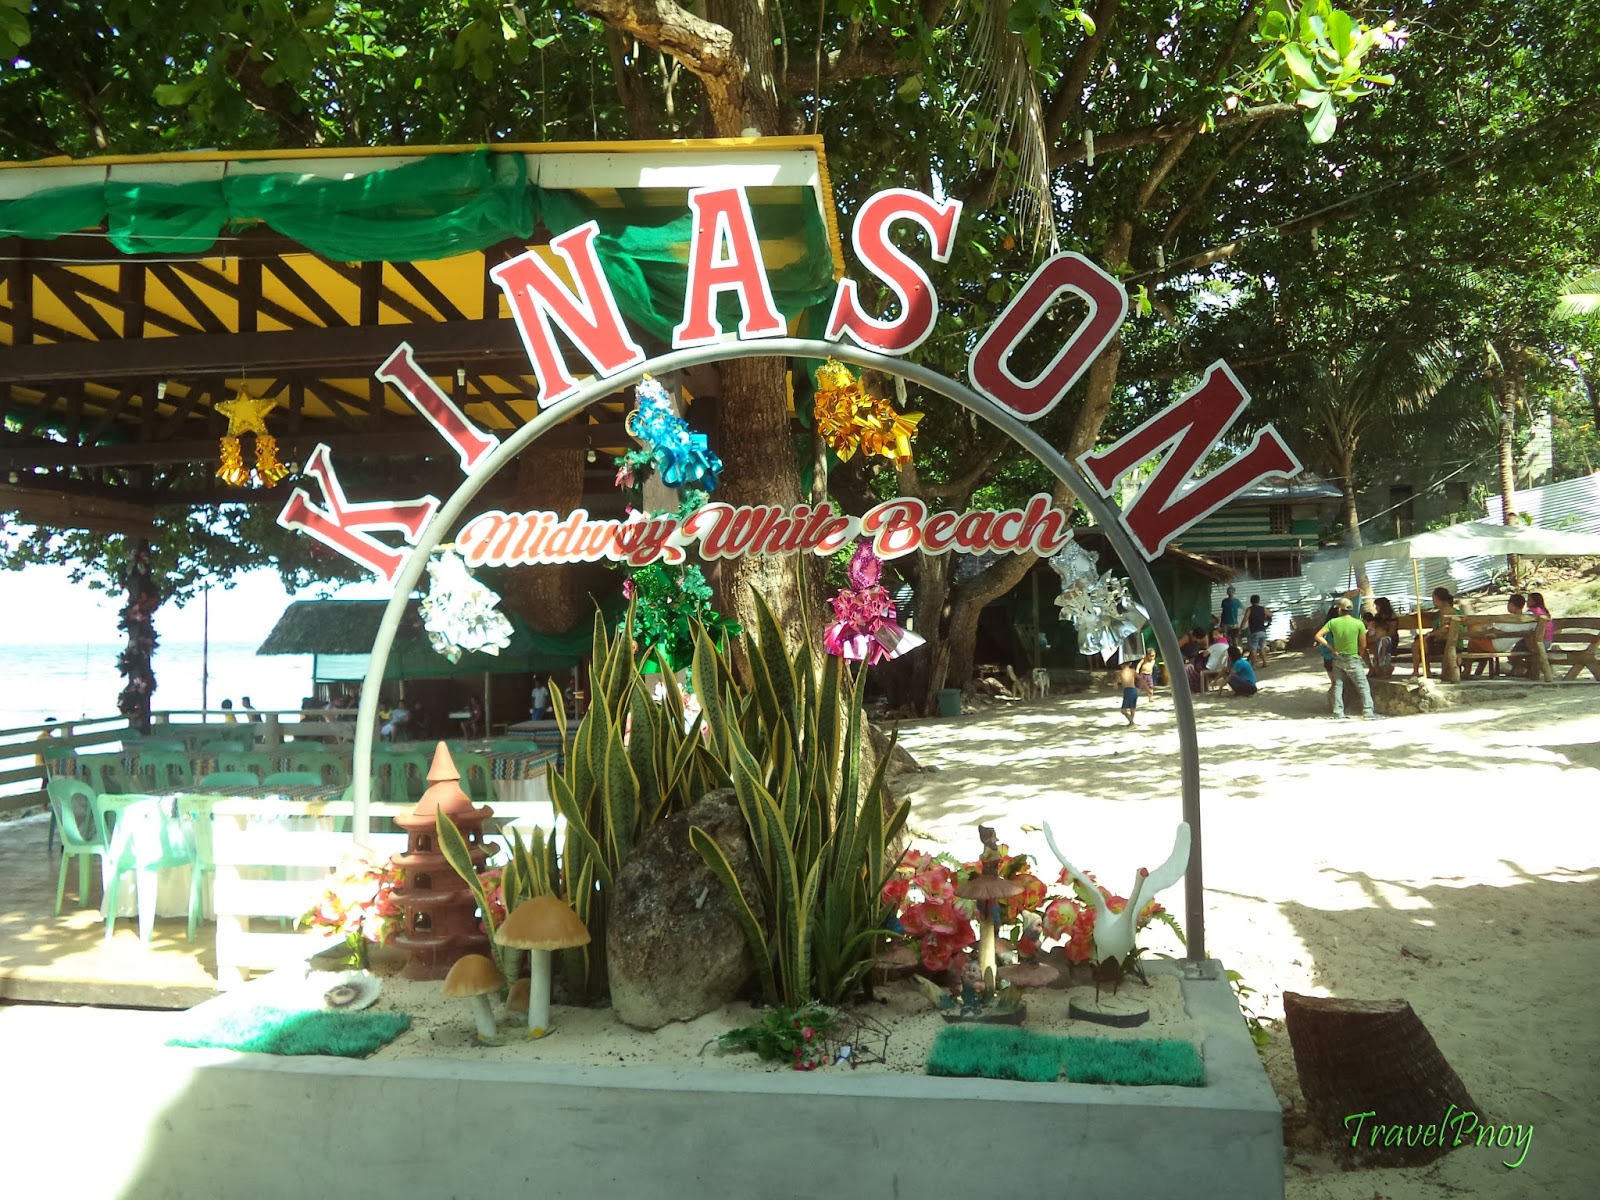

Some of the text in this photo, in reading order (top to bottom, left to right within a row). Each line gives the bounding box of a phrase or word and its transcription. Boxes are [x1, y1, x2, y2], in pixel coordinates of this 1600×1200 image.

[279, 185, 1303, 584] KINASON
[458, 495, 1071, 565] Midway White Beach
